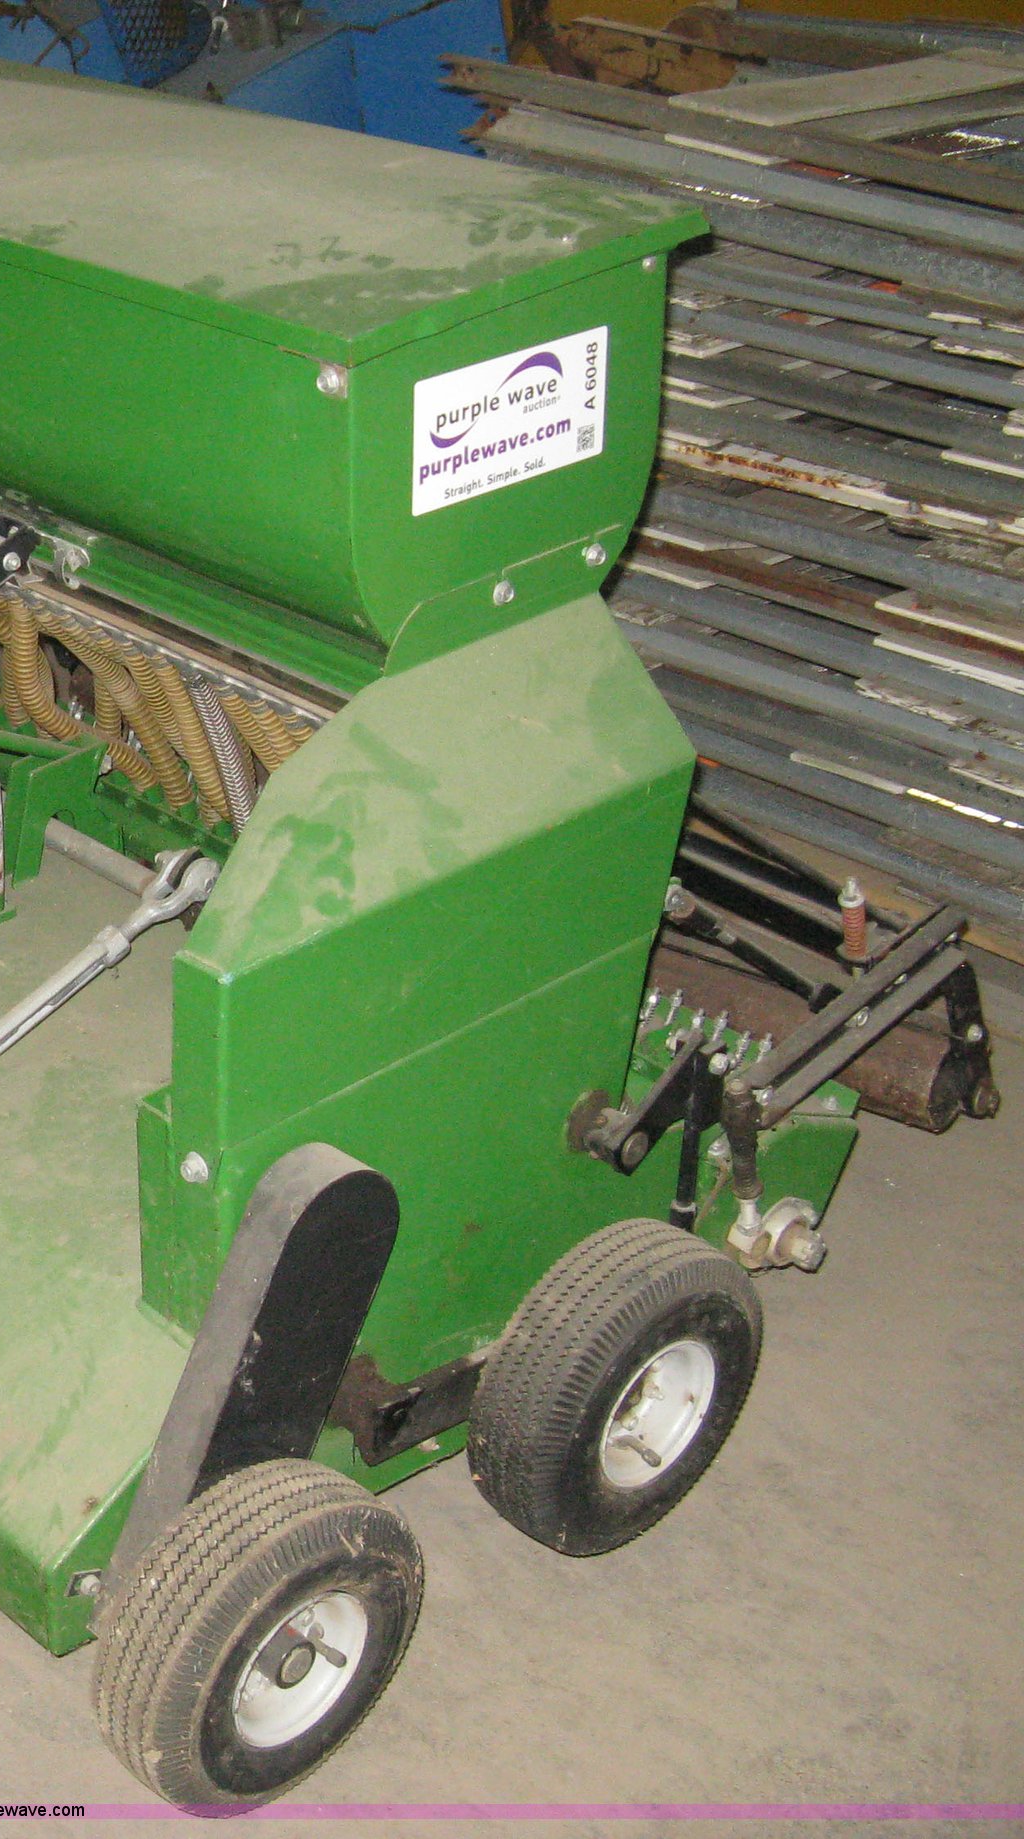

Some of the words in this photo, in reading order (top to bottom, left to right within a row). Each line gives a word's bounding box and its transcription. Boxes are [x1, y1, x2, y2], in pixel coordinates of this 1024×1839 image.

[585, 341, 598, 391] 6048
[436, 393, 500, 433] purple
[508, 377, 558, 406] wave
[584, 396, 596, 410] A
[419, 418, 571, 485] purplewave.com
[444, 477, 484, 499] Straight.
[487, 467, 521, 485] Simple.
[524, 456, 546, 472] Sold.
